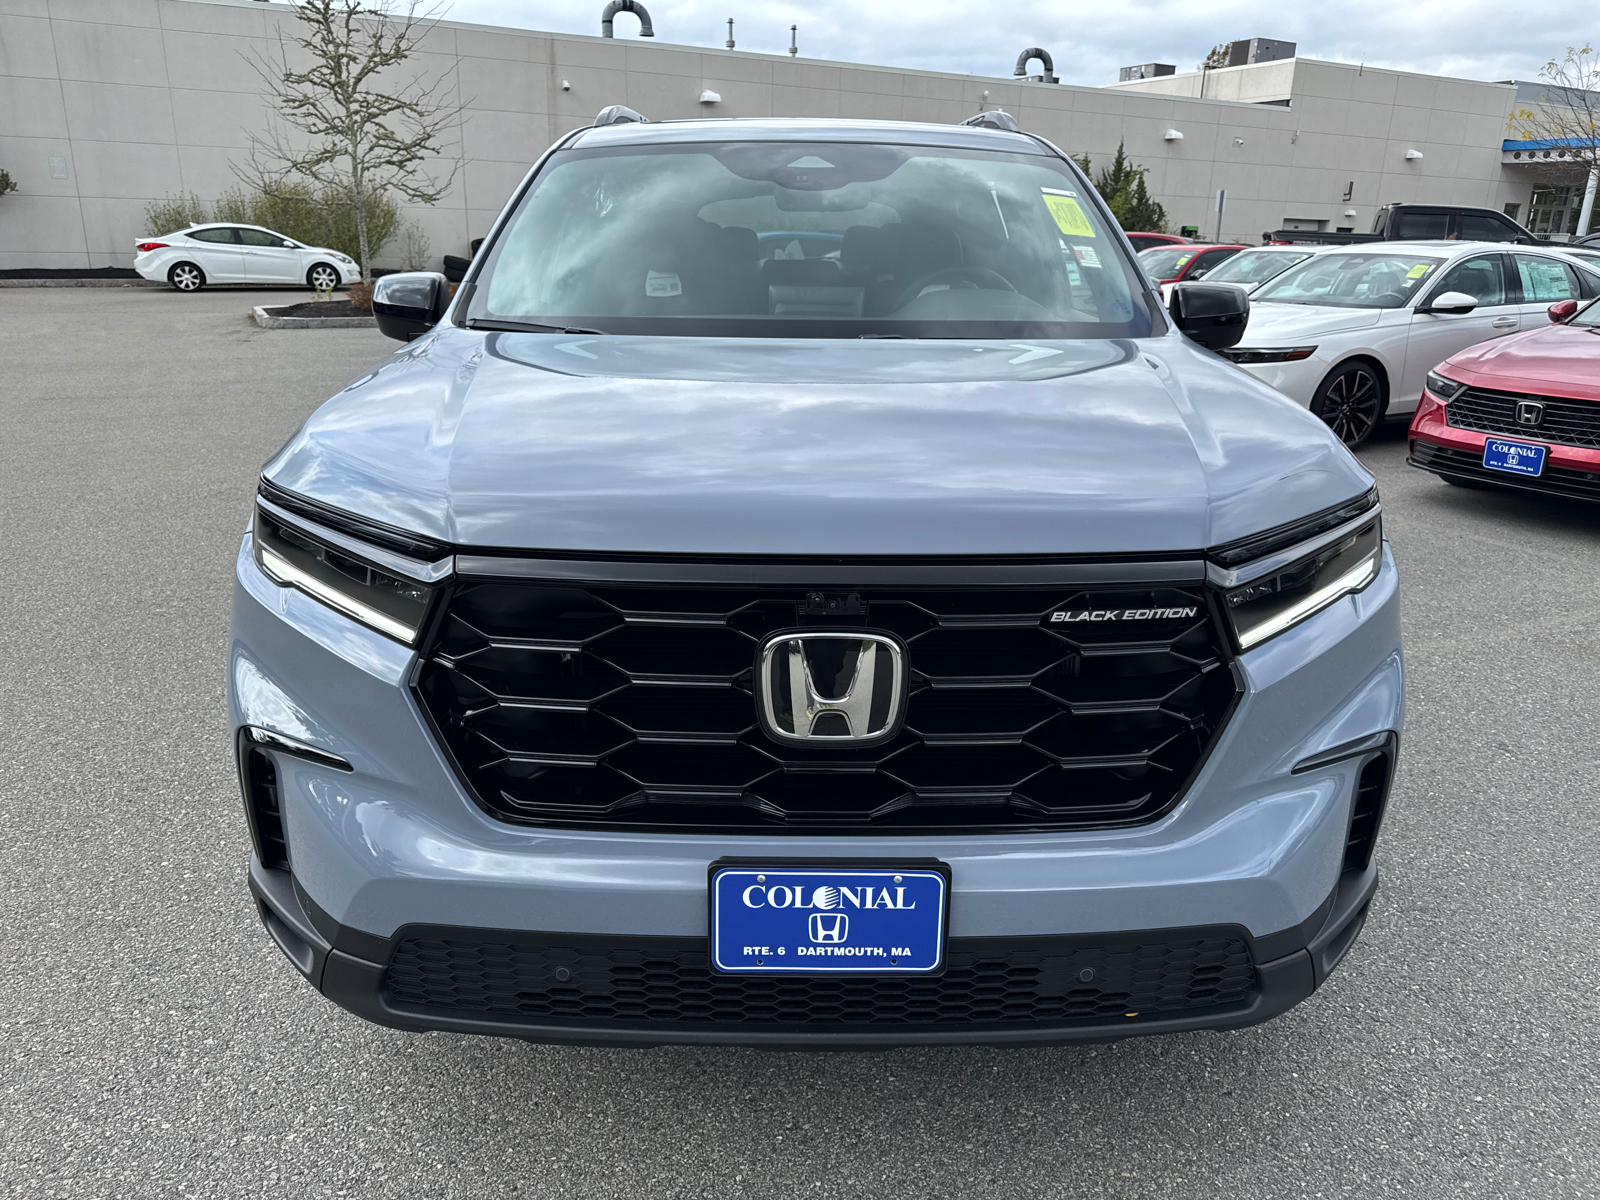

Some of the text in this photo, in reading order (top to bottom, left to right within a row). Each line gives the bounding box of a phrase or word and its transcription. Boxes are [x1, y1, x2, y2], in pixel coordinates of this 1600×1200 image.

[1492, 443, 1537, 458] COLONIAL
[1050, 606, 1198, 622] BLACK EDITION
[742, 884, 916, 910] COLONIAL
[743, 946, 912, 958] RTE. 6 DARTMOUTH, MA
